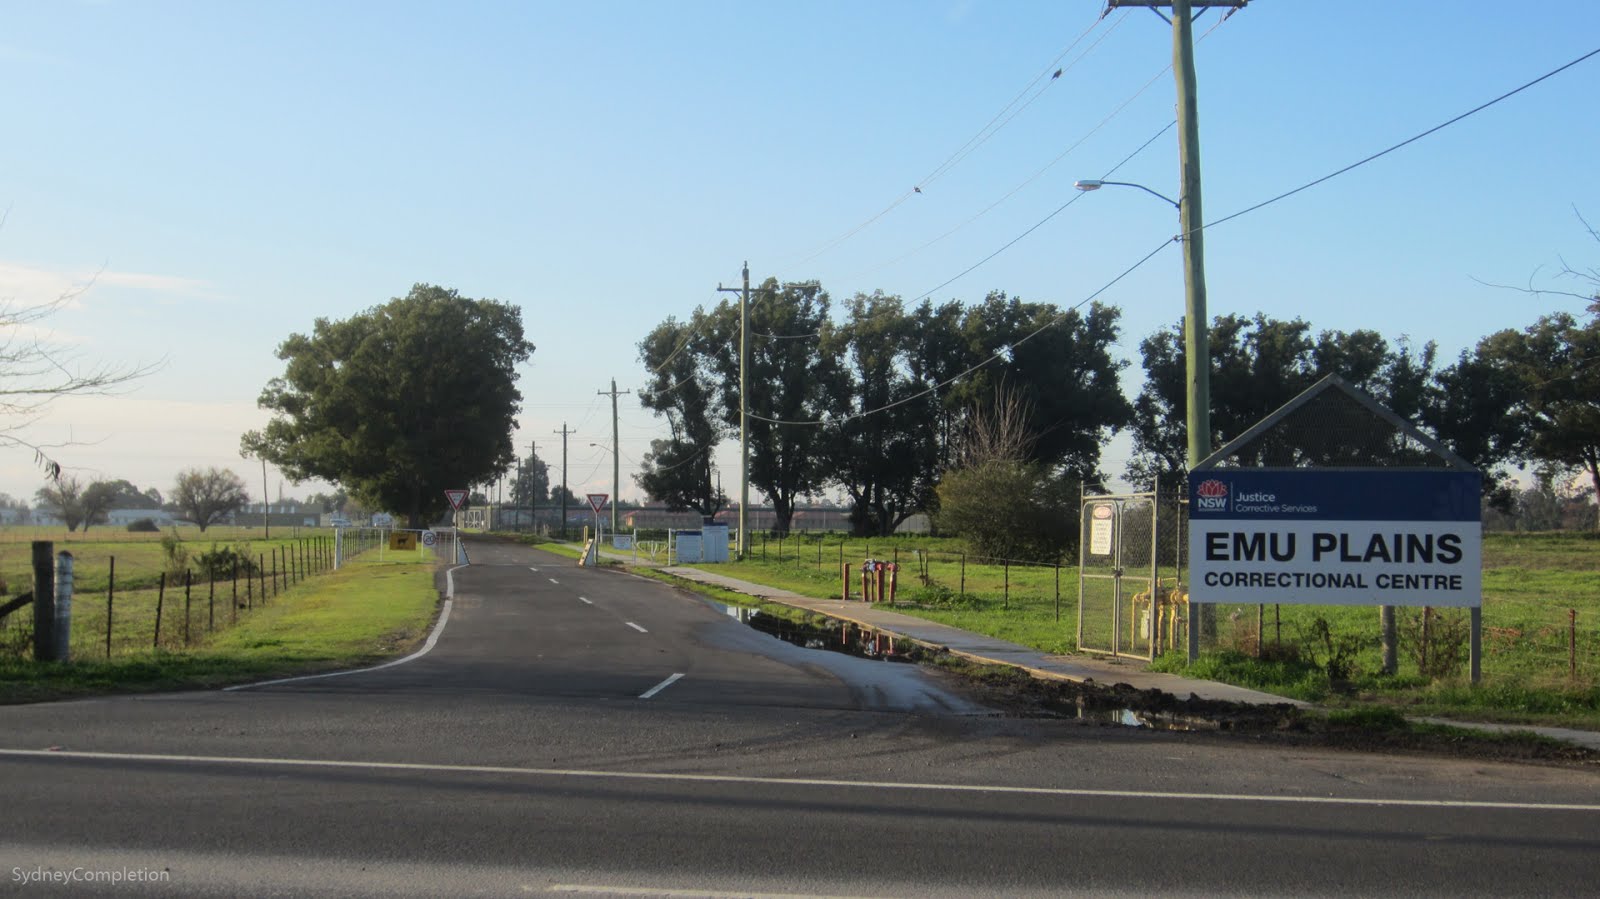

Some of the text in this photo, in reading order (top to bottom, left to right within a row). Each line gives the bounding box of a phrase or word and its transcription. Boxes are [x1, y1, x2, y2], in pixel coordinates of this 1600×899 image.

[1236, 492, 1276, 502] Justice
[1198, 498, 1227, 508] NSW
[1235, 503, 1280, 513] Corrective
[1281, 504, 1318, 513] Services
[1206, 532, 1463, 564] EMU PLAINS
[1204, 572, 1462, 590] CORRECTIONAL CENTRE
